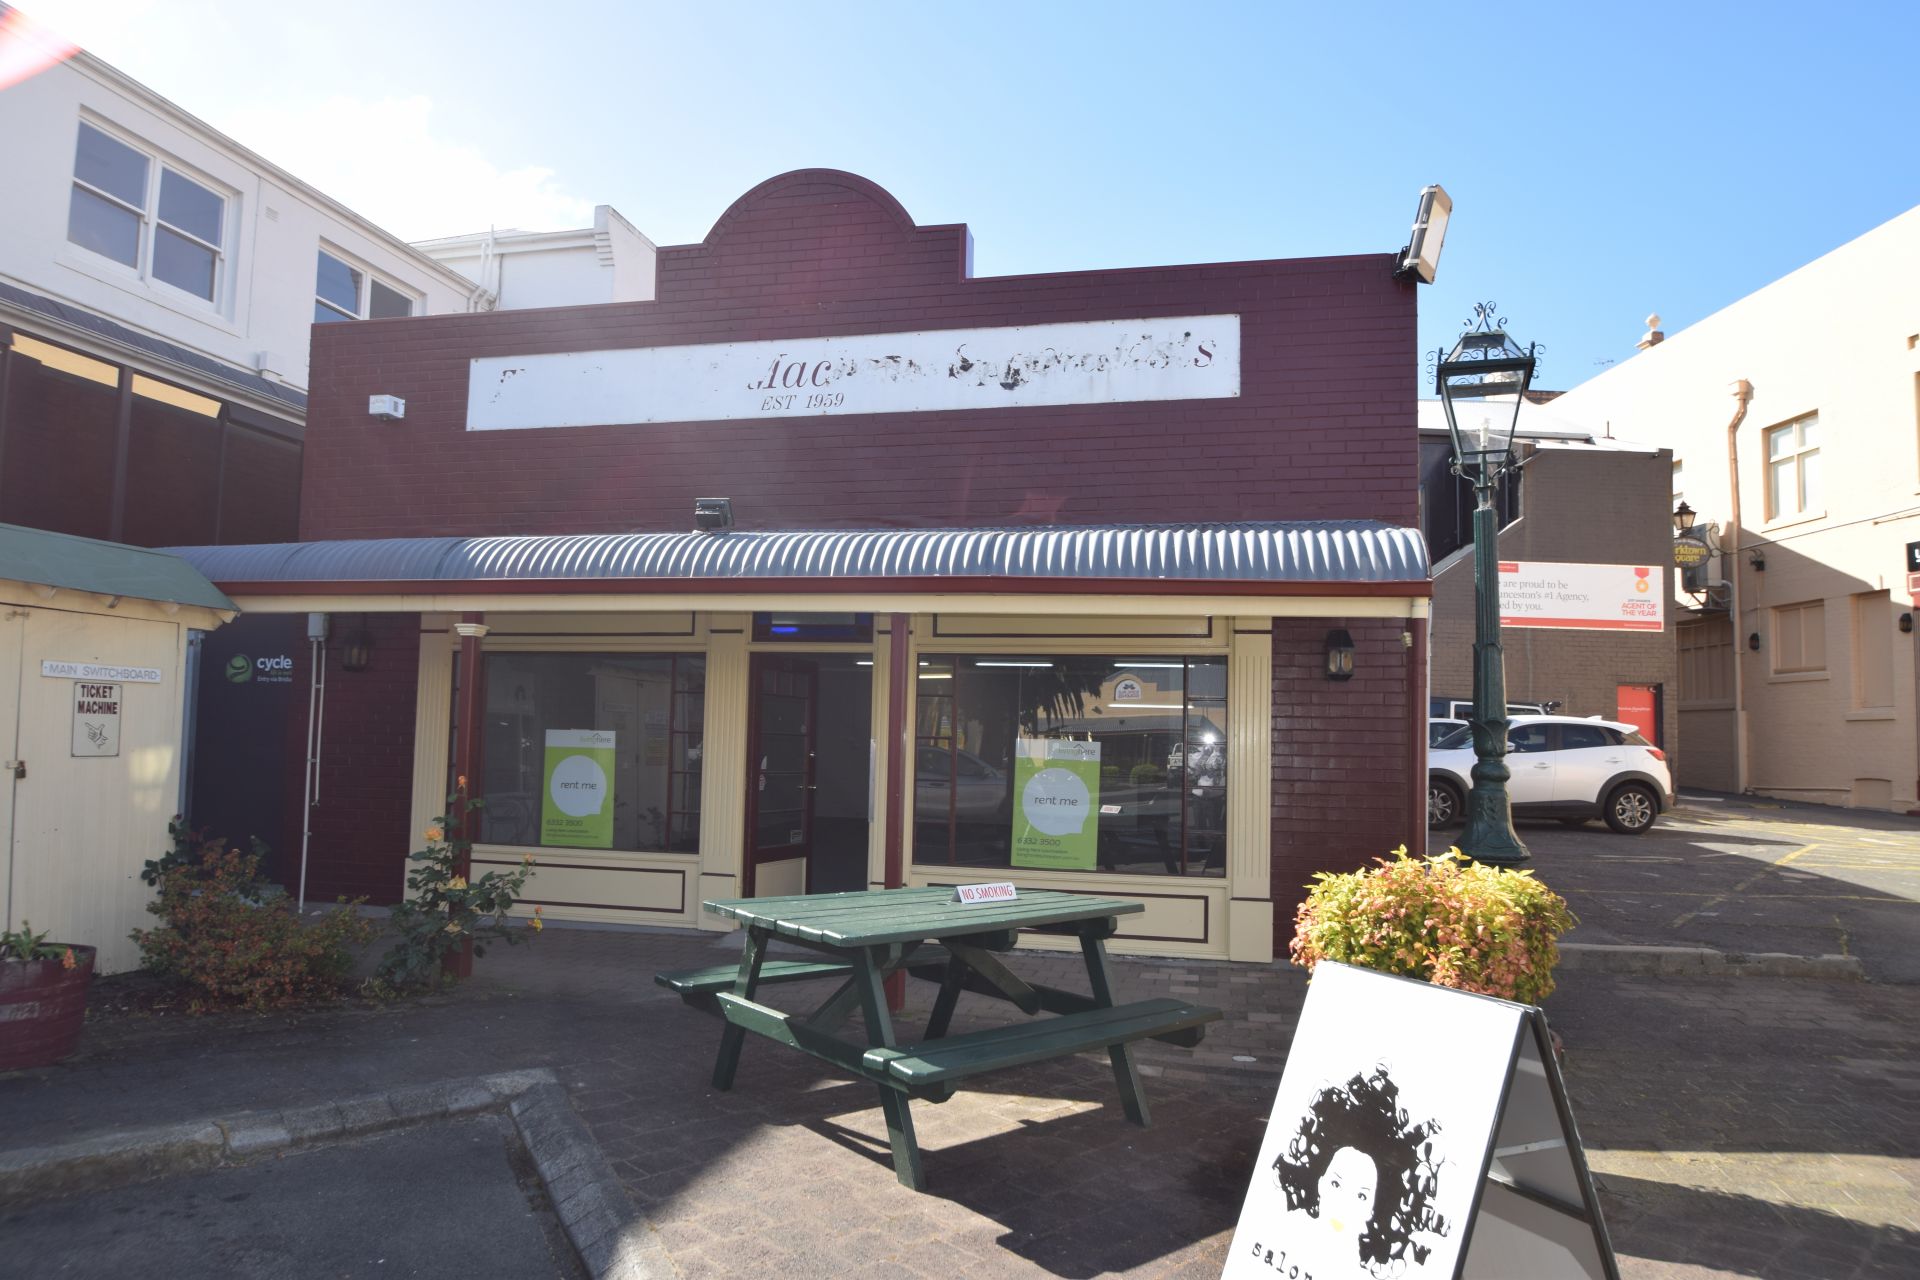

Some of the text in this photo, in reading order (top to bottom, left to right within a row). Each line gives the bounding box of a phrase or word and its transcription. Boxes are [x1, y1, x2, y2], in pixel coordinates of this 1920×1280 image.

[761, 392, 844, 411] EST 1959
[1503, 579, 1569, 590] are proud to be
[1512, 600, 1522, 611] by
[256, 654, 293, 671] cycle
[48, 664, 160, 680] MAIN SWITCHBOARD
[80, 684, 114, 699] TICKET
[77, 700, 118, 715] MACHINE
[560, 781, 597, 790] rent me
[1034, 796, 1078, 806] rent me
[962, 885, 1013, 900] NO SMOKING
